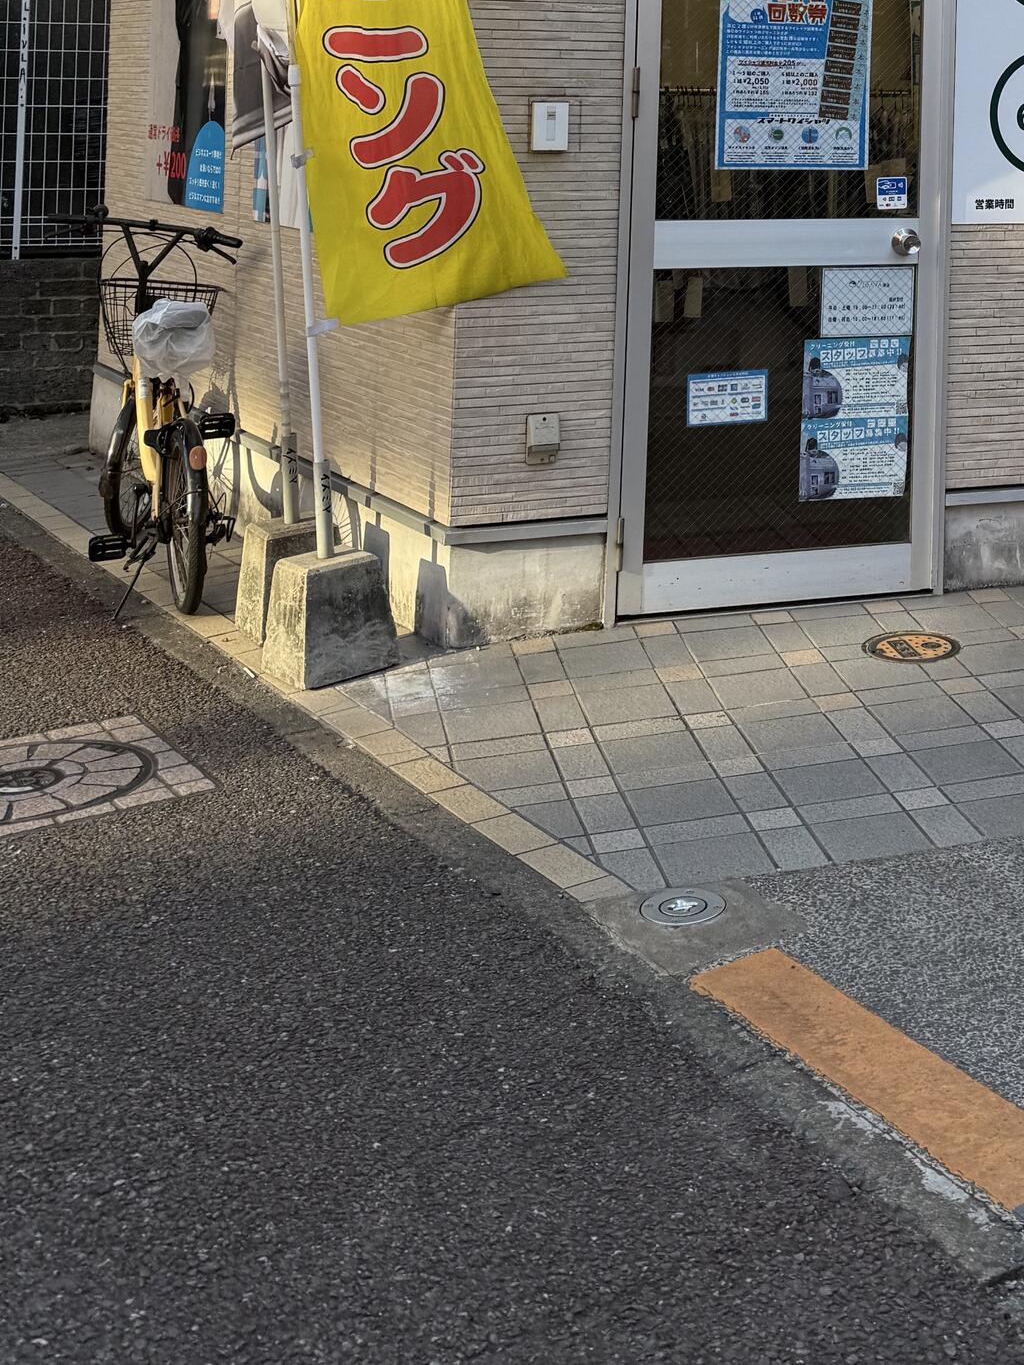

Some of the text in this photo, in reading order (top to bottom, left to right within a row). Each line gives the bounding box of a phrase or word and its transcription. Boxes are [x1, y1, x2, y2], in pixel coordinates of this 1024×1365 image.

[767, 3, 828, 25] 回数券
[757, 117, 831, 125] スマートワイシャツ
[975, 199, 1015, 210] 営業時間
